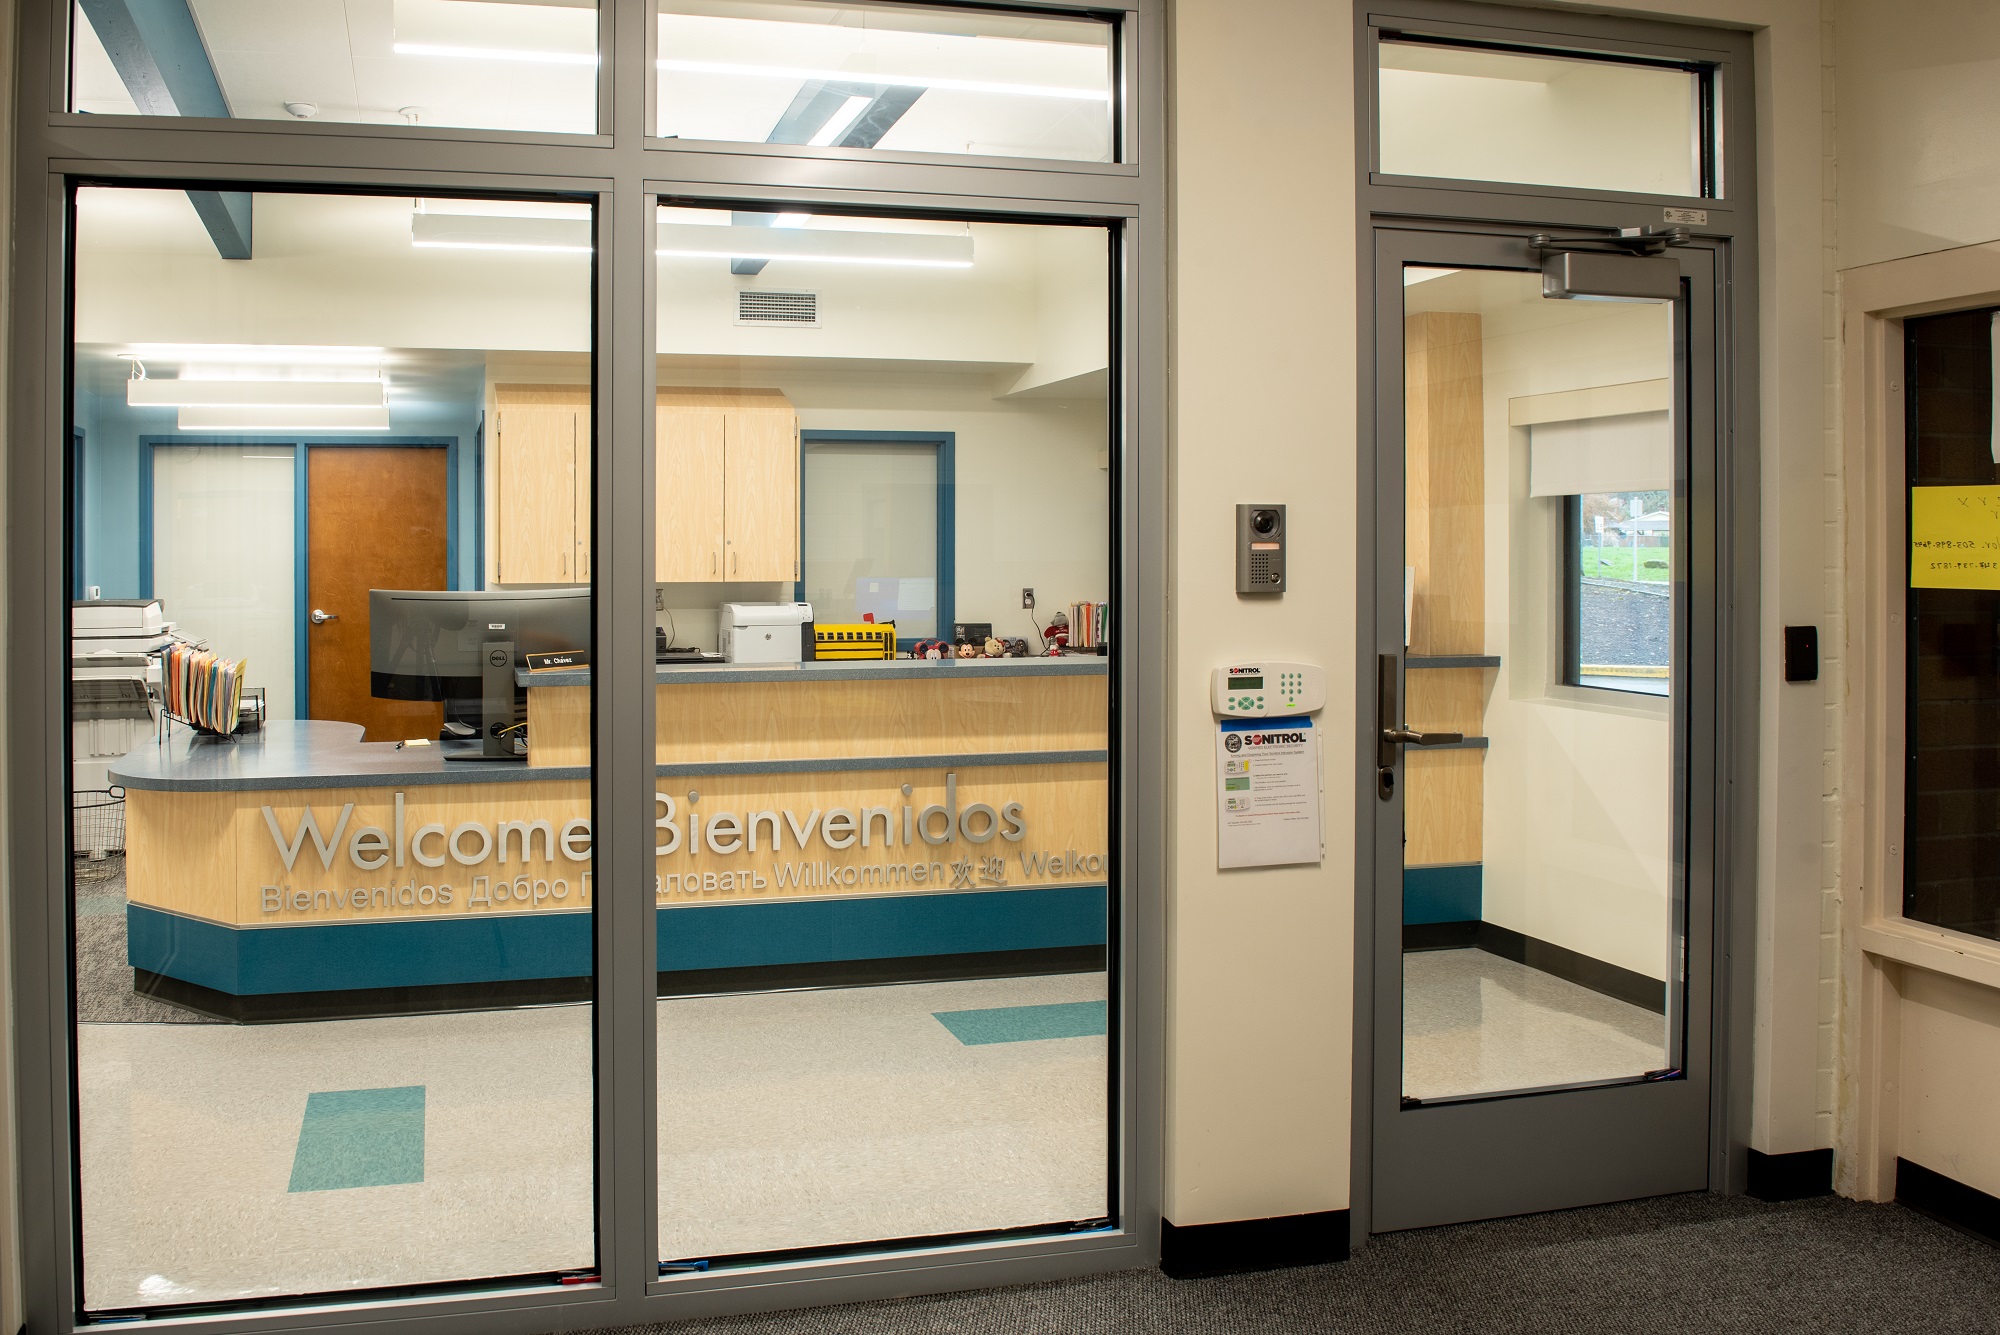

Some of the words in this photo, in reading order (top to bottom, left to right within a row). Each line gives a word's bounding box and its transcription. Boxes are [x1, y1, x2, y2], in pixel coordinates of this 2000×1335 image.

[1244, 732, 1307, 746] SONITROL
[260, 792, 592, 873] Welcome
[656, 773, 1027, 857] Bienvenidos
[261, 879, 454, 913] Bienvenidos
[467, 874, 570, 908] Добро
[773, 858, 944, 889] Willkommen
[948, 855, 1008, 889] 欢迎
[1021, 849, 1108, 878] Welko
